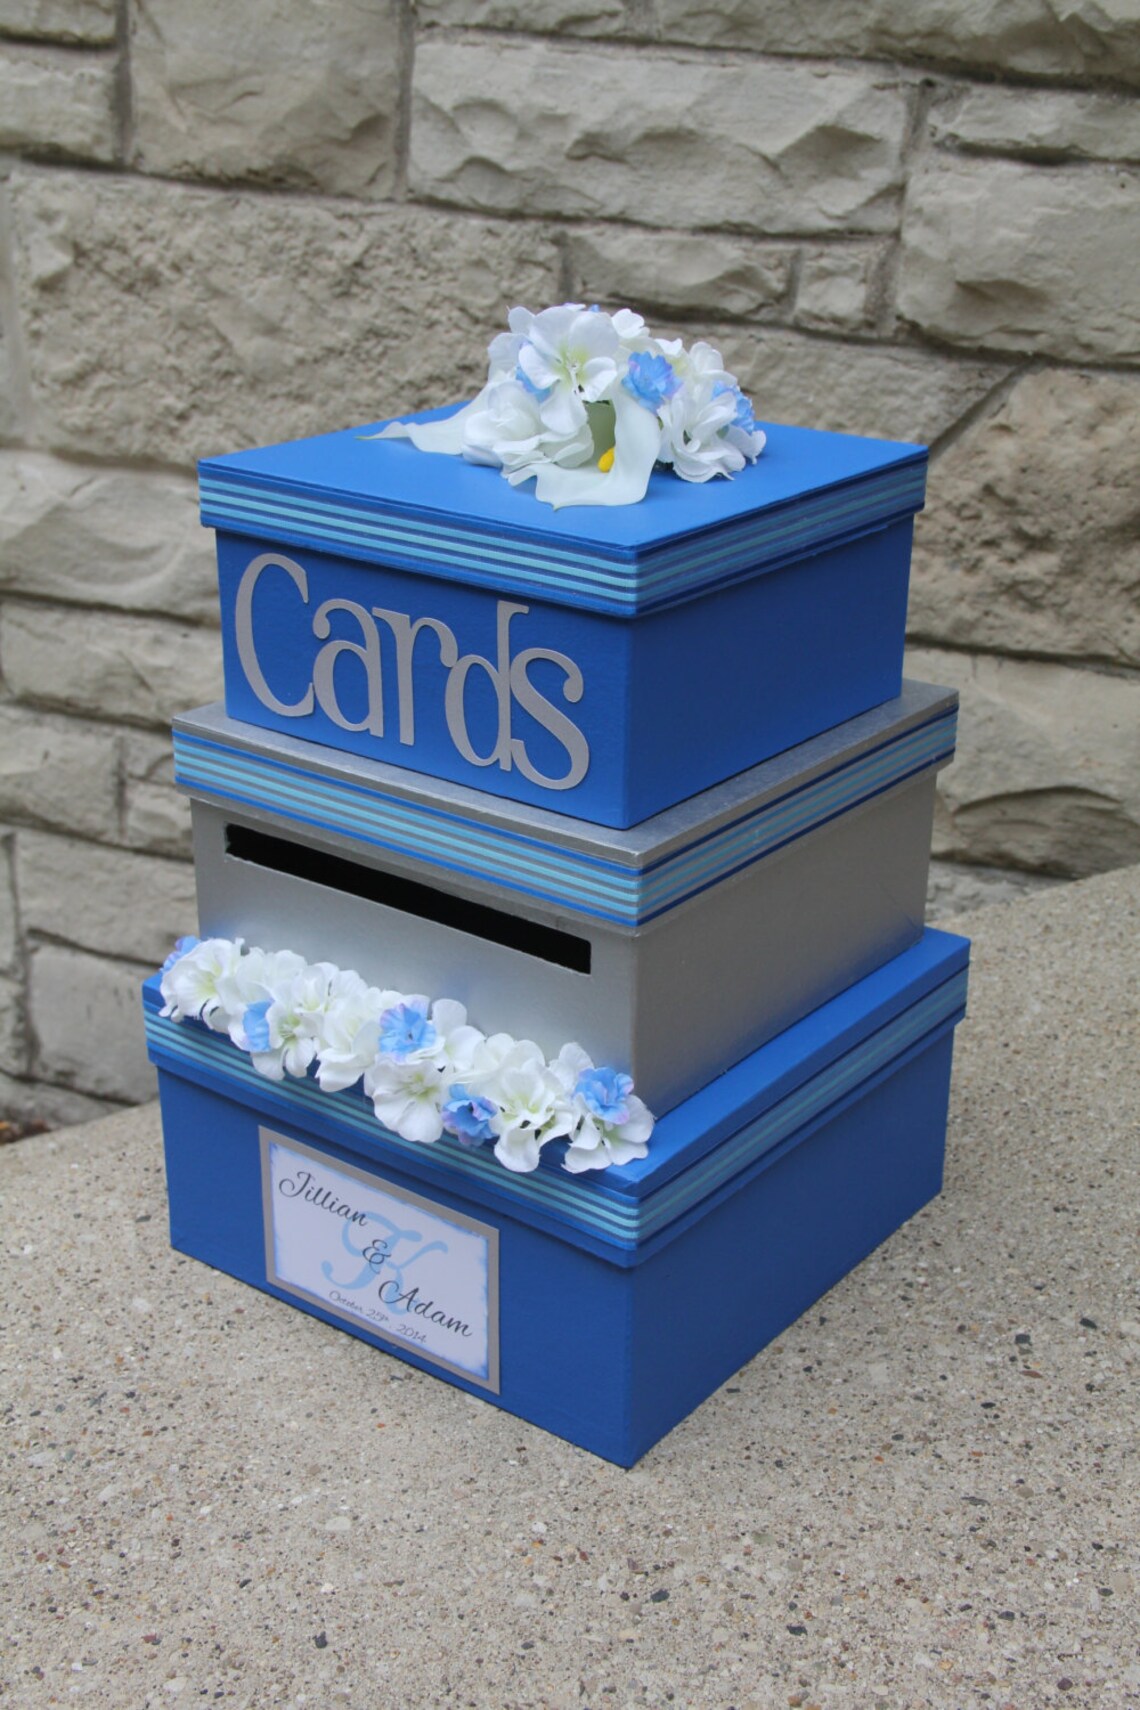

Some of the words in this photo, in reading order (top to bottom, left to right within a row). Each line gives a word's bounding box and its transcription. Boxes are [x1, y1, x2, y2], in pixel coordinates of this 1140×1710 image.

[235, 552, 590, 791] Cards
[278, 1171, 369, 1227] Jillian
[362, 1239, 392, 1274] &
[378, 1280, 473, 1338] Adam
[396, 1323, 428, 1344] 2014
